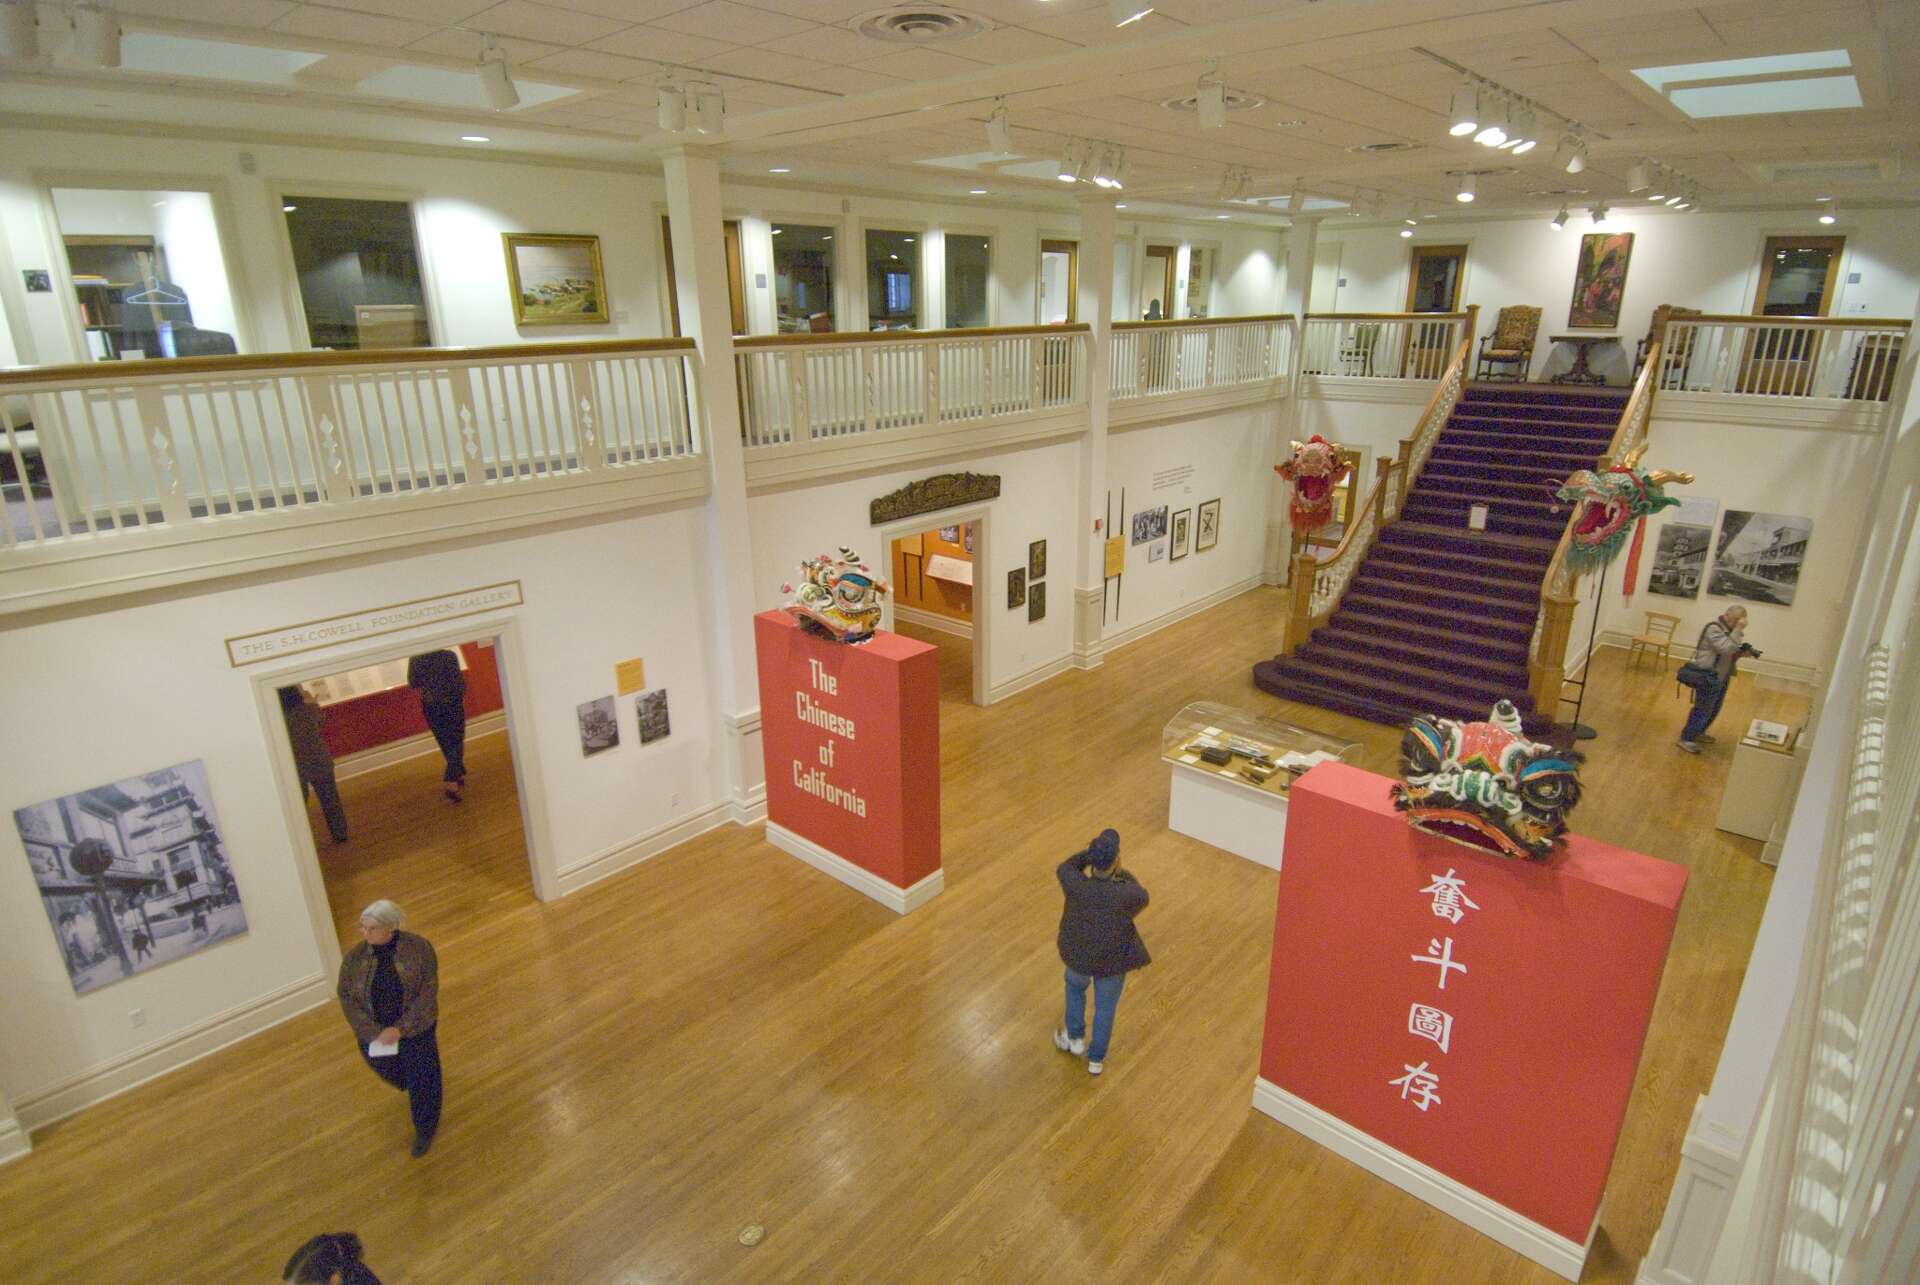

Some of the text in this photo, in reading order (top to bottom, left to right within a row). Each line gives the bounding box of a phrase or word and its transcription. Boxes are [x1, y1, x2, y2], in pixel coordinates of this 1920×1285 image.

[241, 640, 272, 655] THE
[371, 603, 454, 628] FOUNDATION
[460, 591, 513, 609] GALLERY
[809, 658, 837, 696] The
[796, 690, 855, 739] Chinese
[819, 739, 834, 768] of
[793, 759, 866, 818] California
[1388, 867, 1481, 1112] 奮斗圖存
